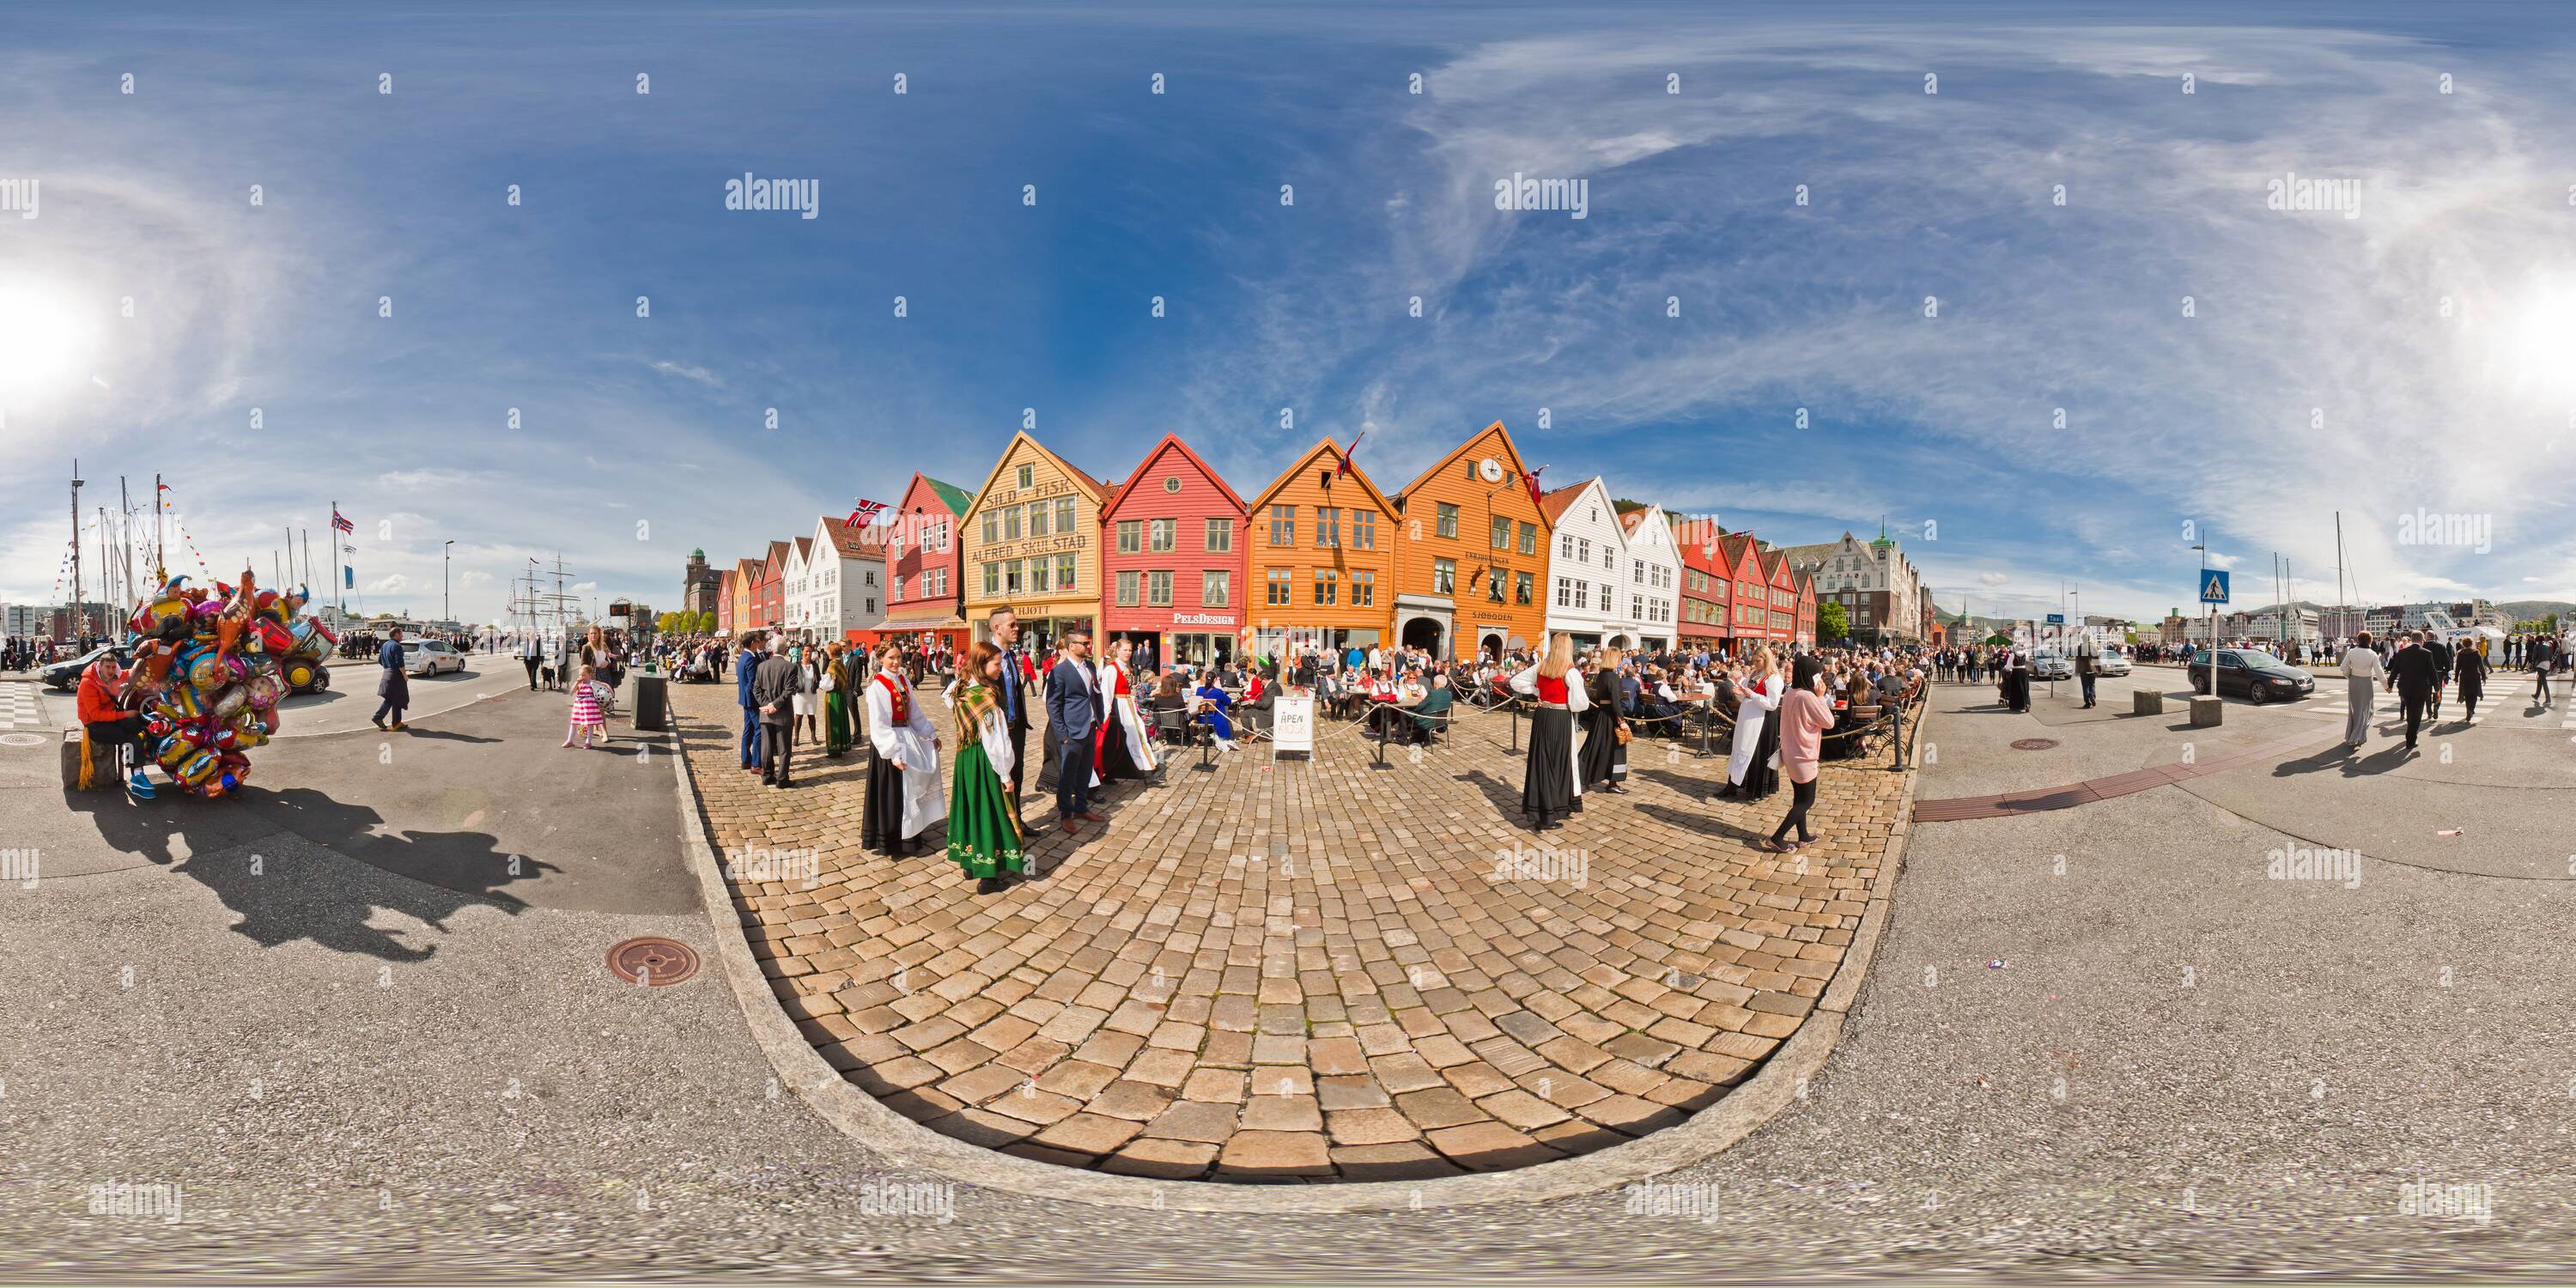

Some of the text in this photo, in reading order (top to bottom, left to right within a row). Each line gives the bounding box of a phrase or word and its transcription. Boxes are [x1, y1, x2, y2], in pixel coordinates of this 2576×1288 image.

[986, 491, 1017, 508] SILD
[1035, 478, 1071, 499] FISK
[971, 535, 1086, 563] ALFRED SKULSTAD
[1013, 605, 1051, 616] CHJØTT
[1472, 611, 1513, 621] SJØBODEN
[1280, 711, 1303, 724] ÅPEN
